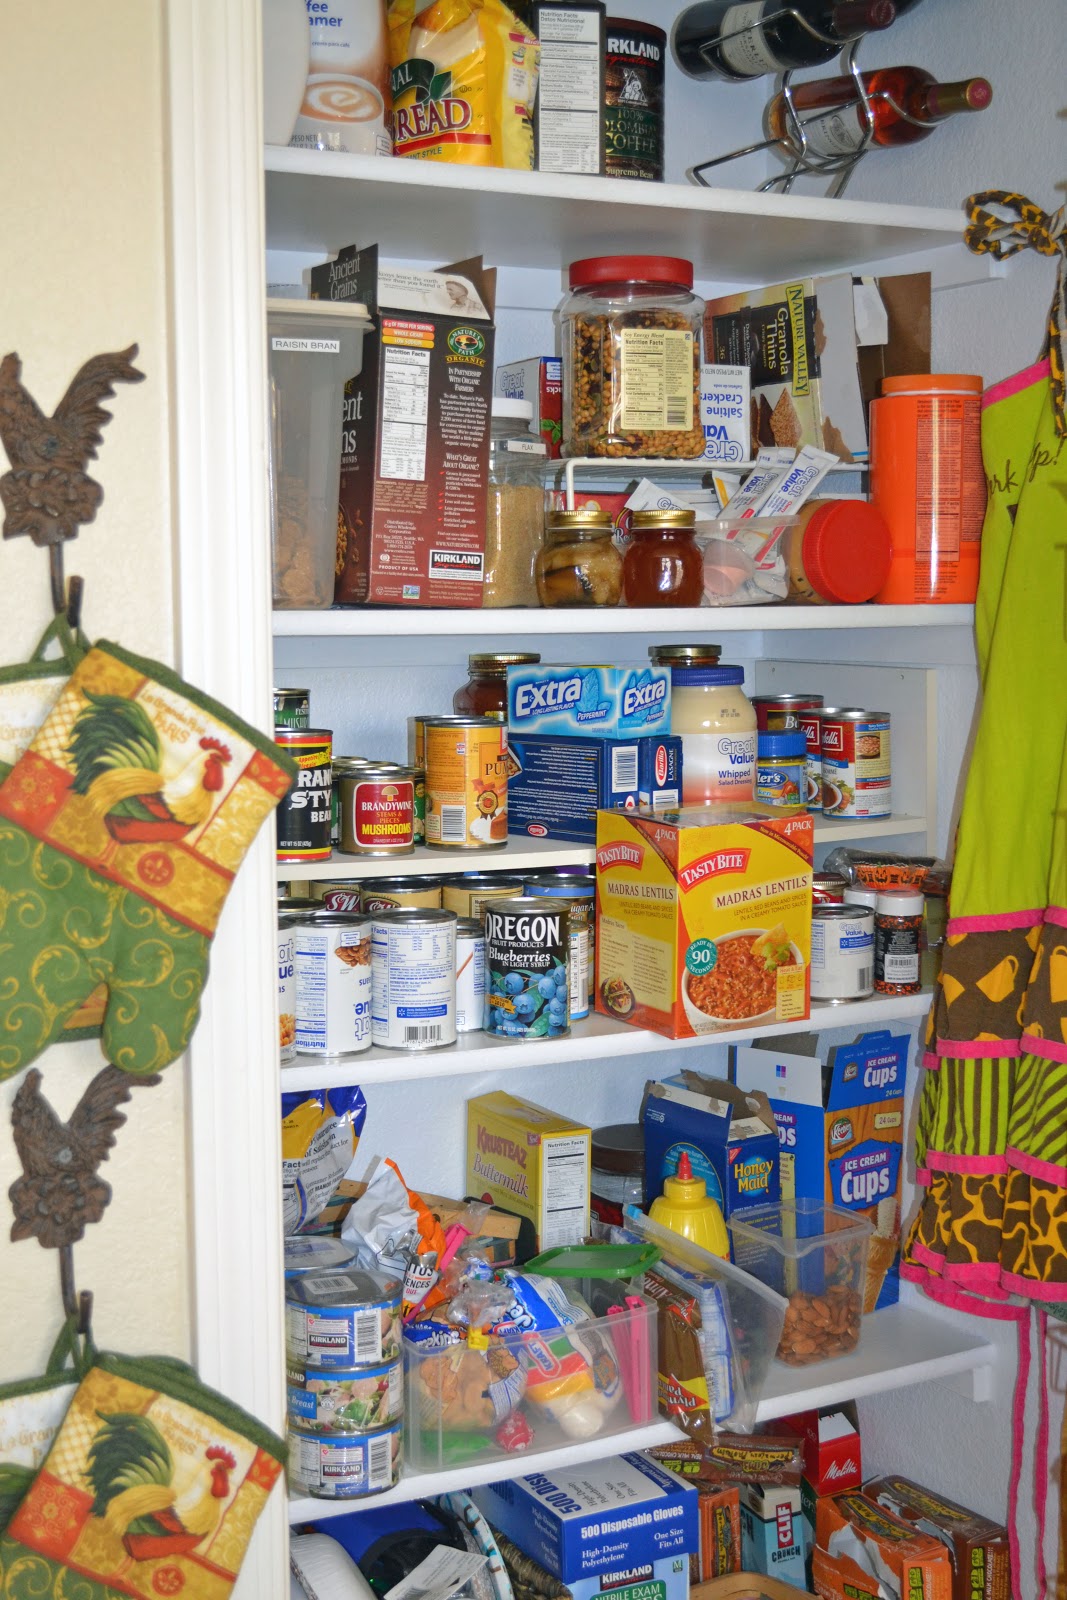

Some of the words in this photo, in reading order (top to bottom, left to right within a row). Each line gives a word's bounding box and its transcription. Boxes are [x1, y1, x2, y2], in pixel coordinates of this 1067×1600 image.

[607, 38, 660, 61] RKLAND
[618, 109, 644, 121] 100%
[421, 147, 442, 159] STYLE
[606, 167, 638, 178] Supremo
[639, 169, 654, 180] Bean
[328, 253, 360, 283] Ancient
[330, 276, 358, 302] Grains
[789, 289, 804, 342] NATURE
[275, 340, 309, 350] RAISIN
[311, 342, 338, 351] BRAN
[766, 319, 778, 370] Thins
[777, 307, 792, 376] Granola
[386, 348, 411, 356] Nutrition
[457, 348, 475, 356] PATH
[720, 346, 726, 360] 36
[446, 356, 486, 367] ORGANIC
[796, 343, 809, 393] VALLEY
[501, 368, 525, 392] Great
[706, 407, 743, 419] Saltine
[521, 443, 534, 451] FLAX
[743, 475, 764, 493] Value
[780, 468, 805, 493] Value
[787, 465, 820, 498] Great
[434, 553, 481, 565] KIRKLAND
[515, 677, 582, 717] Extra
[623, 679, 666, 716] Extra
[532, 708, 544, 716] LONG
[544, 705, 559, 714] LASTING
[558, 702, 574, 711] FLAVOR
[576, 710, 607, 722] PEPPERMINT
[717, 737, 755, 756] Great
[657, 748, 665, 777] Barilla
[729, 753, 755, 765] Value
[718, 769, 751, 780] Whipped
[735, 778, 752, 786] Dressing
[361, 801, 412, 812] BRANDYWINE
[361, 823, 412, 836] MUSHROOMS
[655, 829, 662, 843] 4
[661, 829, 677, 842] PACK
[784, 823, 792, 836] 4
[792, 820, 812, 831] PACK
[598, 846, 622, 867] TASTY
[621, 844, 641, 864] BITE
[681, 858, 717, 886] TASTY
[716, 854, 744, 870] BITE
[607, 883, 639, 897] MADRAS
[641, 886, 674, 900] LENTILS
[716, 886, 762, 908] MADRAS
[765, 875, 807, 896] LENTILS
[326, 893, 361, 912] S&W
[733, 906, 753, 916] LENTILS,
[753, 904, 764, 912] RED
[764, 900, 780, 909] BEANS
[791, 893, 807, 902] SPICES
[751, 910, 770, 919] CREAMY
[770, 904, 791, 914] TOMATO
[791, 899, 807, 909] SAUCE
[484, 912, 561, 947] OREGON
[491, 938, 507, 947] FRUIT
[690, 940, 706, 951] READY
[706, 941, 714, 949] IN
[489, 946, 551, 962] Blueberries
[691, 949, 711, 965] 90
[687, 962, 714, 974] SECONDS
[867, 1059, 876, 1067] ICE
[877, 1055, 897, 1066] CREAM
[864, 1065, 898, 1088] Cups
[885, 1089, 892, 1097] 24
[879, 1116, 887, 1125] 24
[477, 1124, 528, 1170] KRUSTEAZ
[734, 1159, 774, 1180] Honey
[845, 1160, 858, 1172] ICE
[860, 1152, 887, 1168] CREAM
[473, 1152, 529, 1199] Buttermilk
[738, 1175, 768, 1193] Maid
[840, 1167, 890, 1204] Cups
[310, 1335, 346, 1344] KIRKLAND
[291, 1396, 315, 1409] Breast
[323, 1463, 362, 1474] KIRKLAND
[822, 1458, 858, 1482] Melitta
[566, 1481, 598, 1507] High-Density
[614, 1489, 626, 1500] One
[545, 1491, 582, 1515] 500
[581, 1523, 600, 1540] 500
[601, 1512, 653, 1536] Disposable
[653, 1505, 684, 1523] Gloves
[777, 1506, 793, 1544] CLIF
[654, 1531, 670, 1541] One
[670, 1527, 684, 1538] Size
[581, 1541, 630, 1559] High-Density
[658, 1539, 673, 1550] Fits
[673, 1536, 684, 1546] All
[581, 1552, 626, 1569] Polyethylene
[771, 1545, 801, 1562] CRUNCH
[602, 1564, 653, 1584] KIRKLAND
[631, 1584, 661, 1600] EXAM
